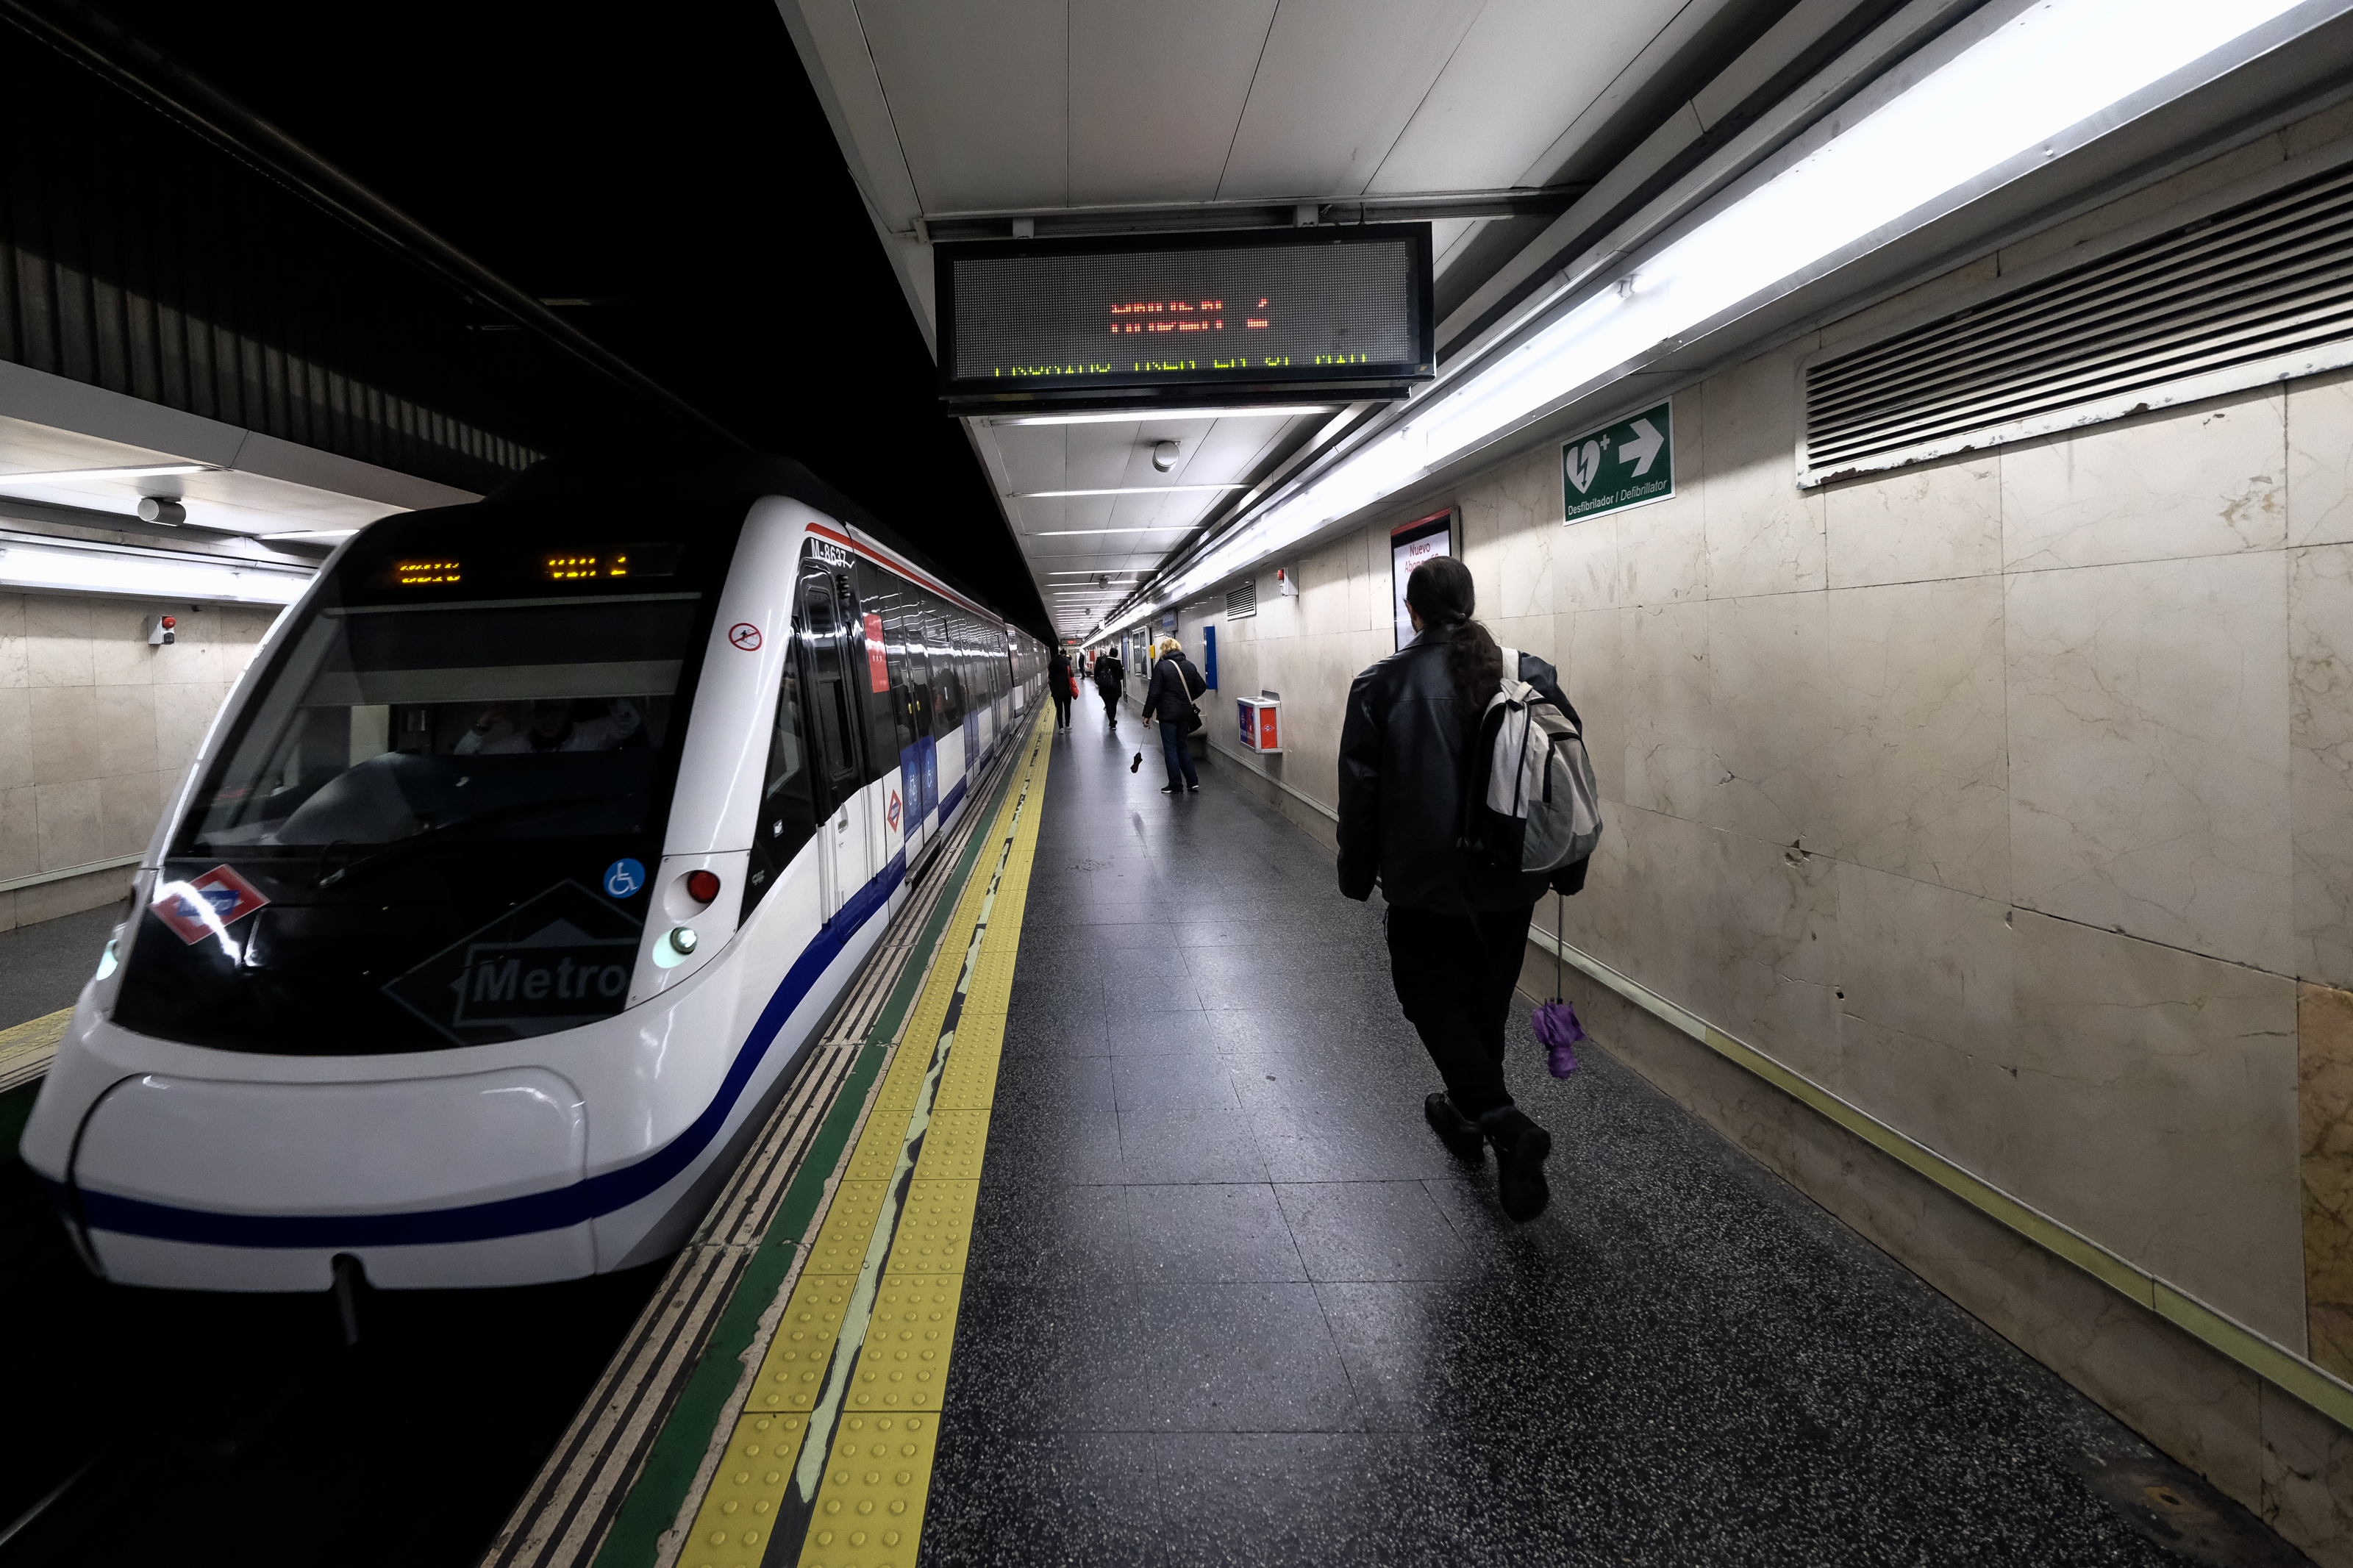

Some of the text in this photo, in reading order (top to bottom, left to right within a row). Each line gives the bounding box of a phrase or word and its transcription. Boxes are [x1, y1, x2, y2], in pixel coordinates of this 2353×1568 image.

[1568, 494, 1614, 515] Desfibrilador
[1621, 480, 1667, 501] Defibrillator
[811, 538, 846, 568] M-8637
[1410, 543, 1430, 556] Nuevo
[473, 957, 626, 1002] Metro
